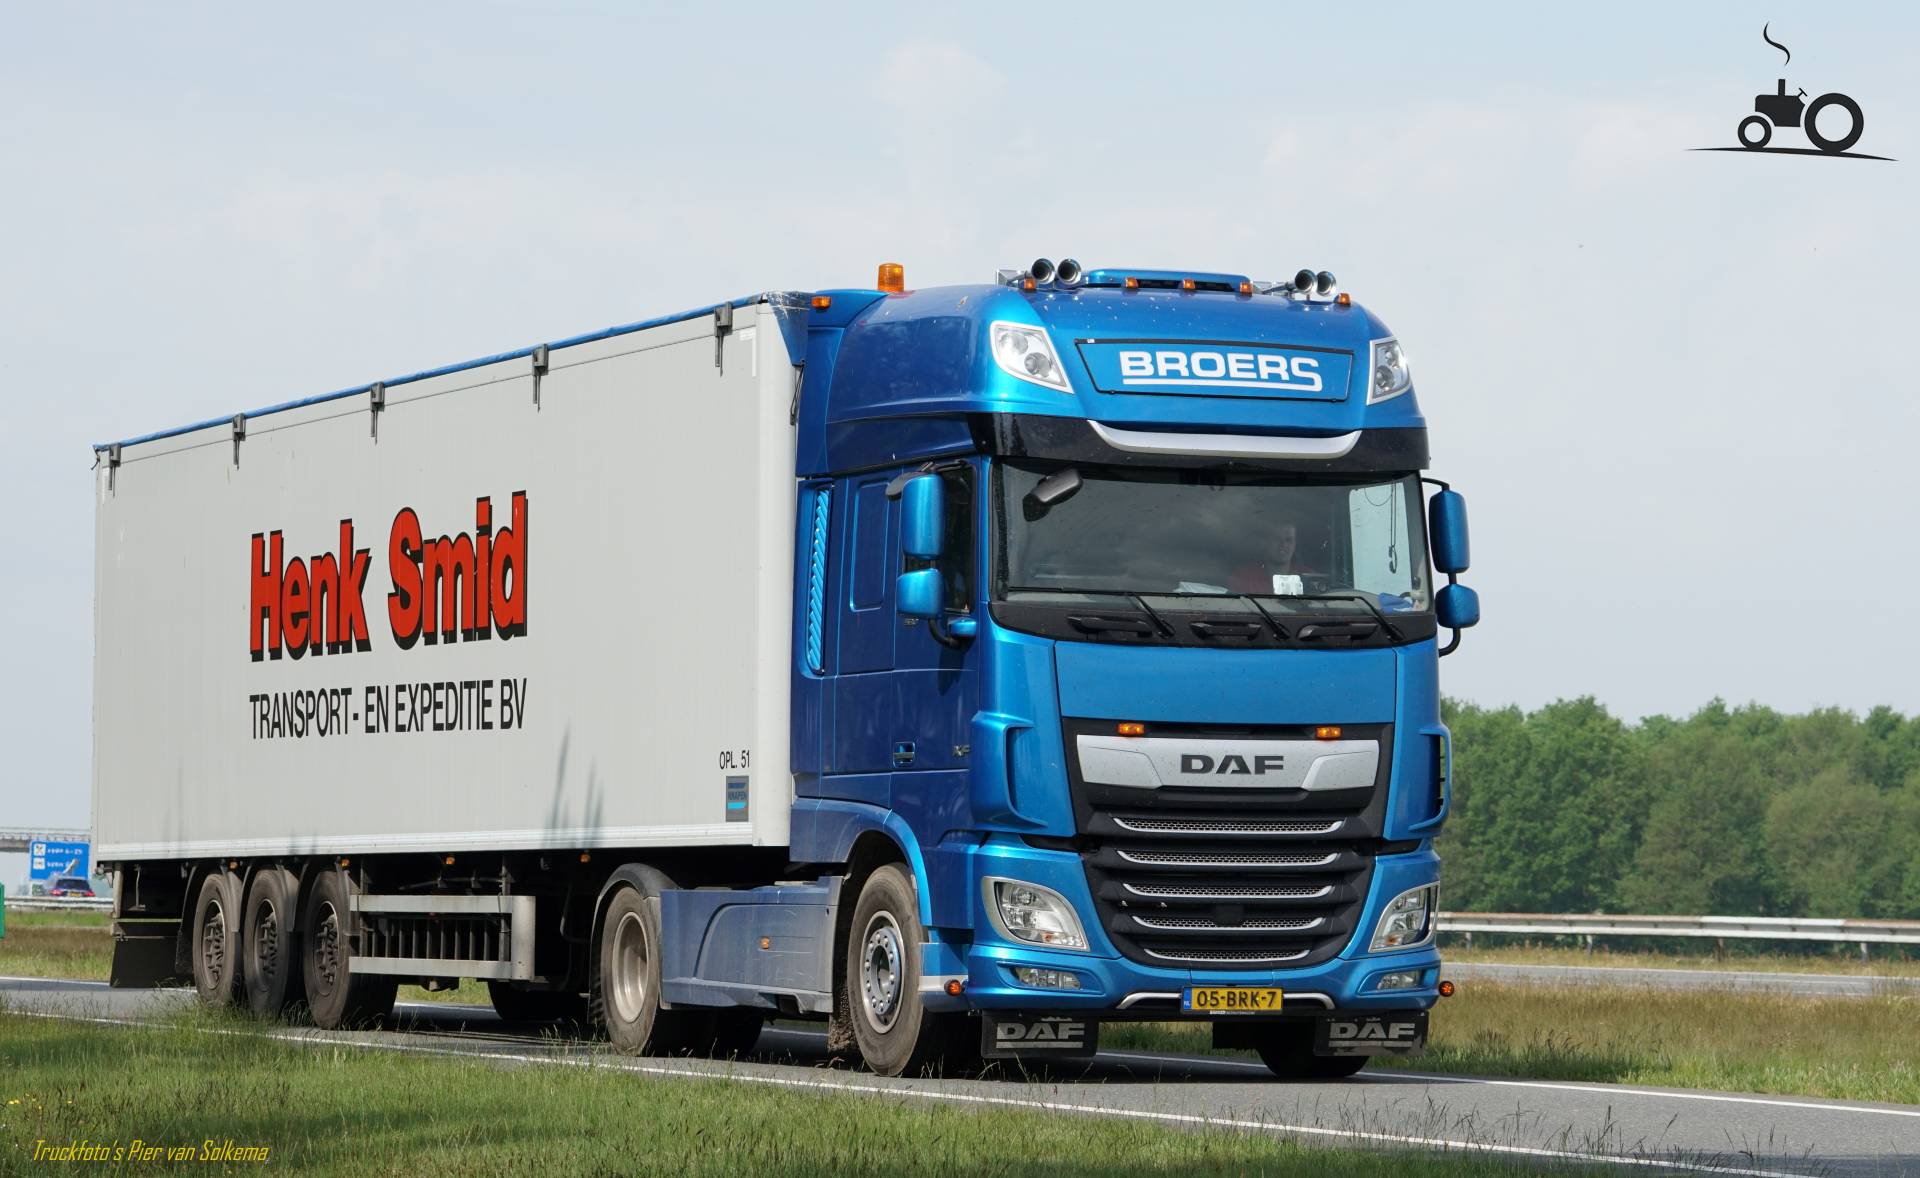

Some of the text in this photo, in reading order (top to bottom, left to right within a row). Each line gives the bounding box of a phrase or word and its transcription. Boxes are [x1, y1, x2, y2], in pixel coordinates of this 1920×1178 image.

[1119, 350, 1322, 392] BROERS
[250, 490, 529, 662] Henk Smid
[365, 685, 389, 734] EN
[395, 680, 493, 733] EXPEDITIE
[500, 678, 527, 729] BV
[719, 749, 750, 770] OPL. 51
[1180, 754, 1284, 774] DAF
[1196, 991, 1277, 1008] 05-BRK-7
[996, 1022, 1085, 1040] DAF
[1329, 1022, 1415, 1039] DAF
